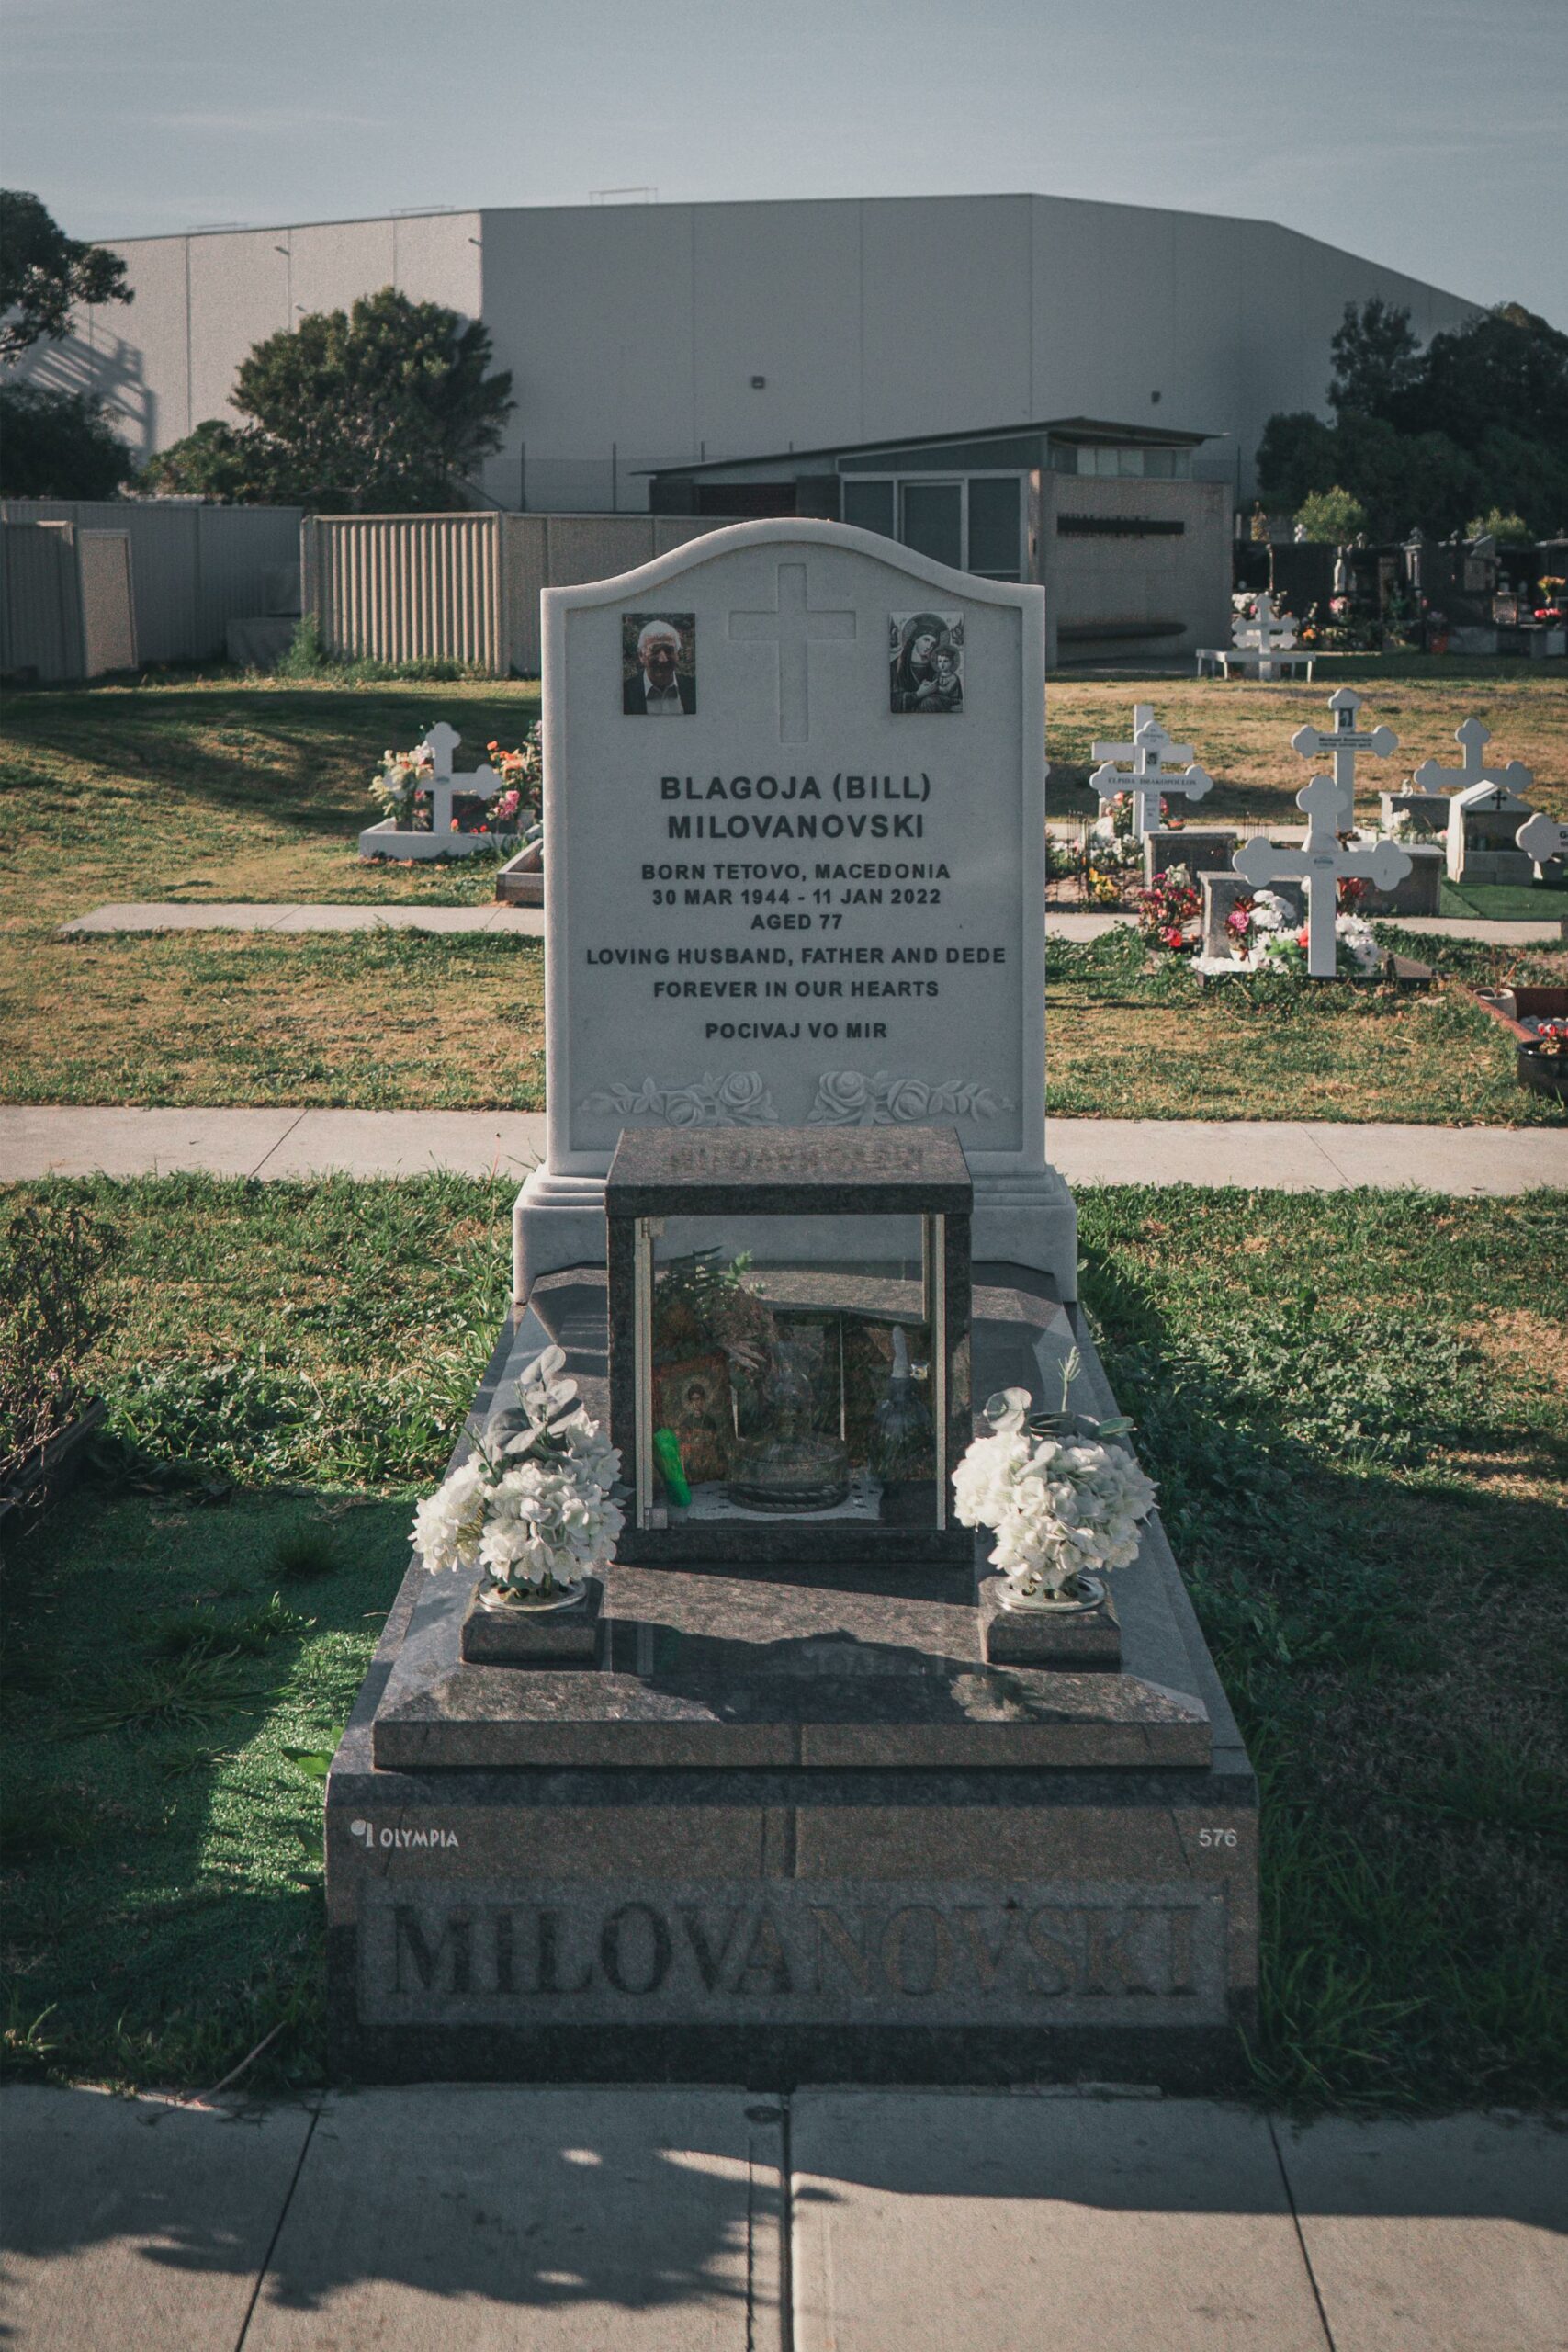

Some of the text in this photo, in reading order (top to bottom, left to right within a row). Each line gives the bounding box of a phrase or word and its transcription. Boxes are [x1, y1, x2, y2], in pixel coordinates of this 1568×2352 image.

[661, 773, 932, 804] BLAGOJA (BILL)
[668, 814, 924, 840] MILOVANOVSKI
[642, 864, 952, 883] BORN TETOVO, MACEDONIA
[653, 889, 678, 907] 30
[684, 889, 734, 907] MAR
[741, 889, 792, 906] 1944
[813, 889, 832, 906] 11
[840, 889, 884, 906] JAN
[891, 889, 942, 906] 2022
[750, 914, 844, 932] AGED 77
[587, 948, 1007, 967] LOVING HUSBAND, FATHER AND DEDE
[654, 981, 940, 999] FOREVER IN OUR HEARTS
[705, 1023, 888, 1041] POCIVAJ VO MIR
[379, 1828, 459, 1848] OLYMPIA
[1199, 1828, 1237, 1847] 576
[386, 1901, 1198, 1996] MILOVANOVSKI
